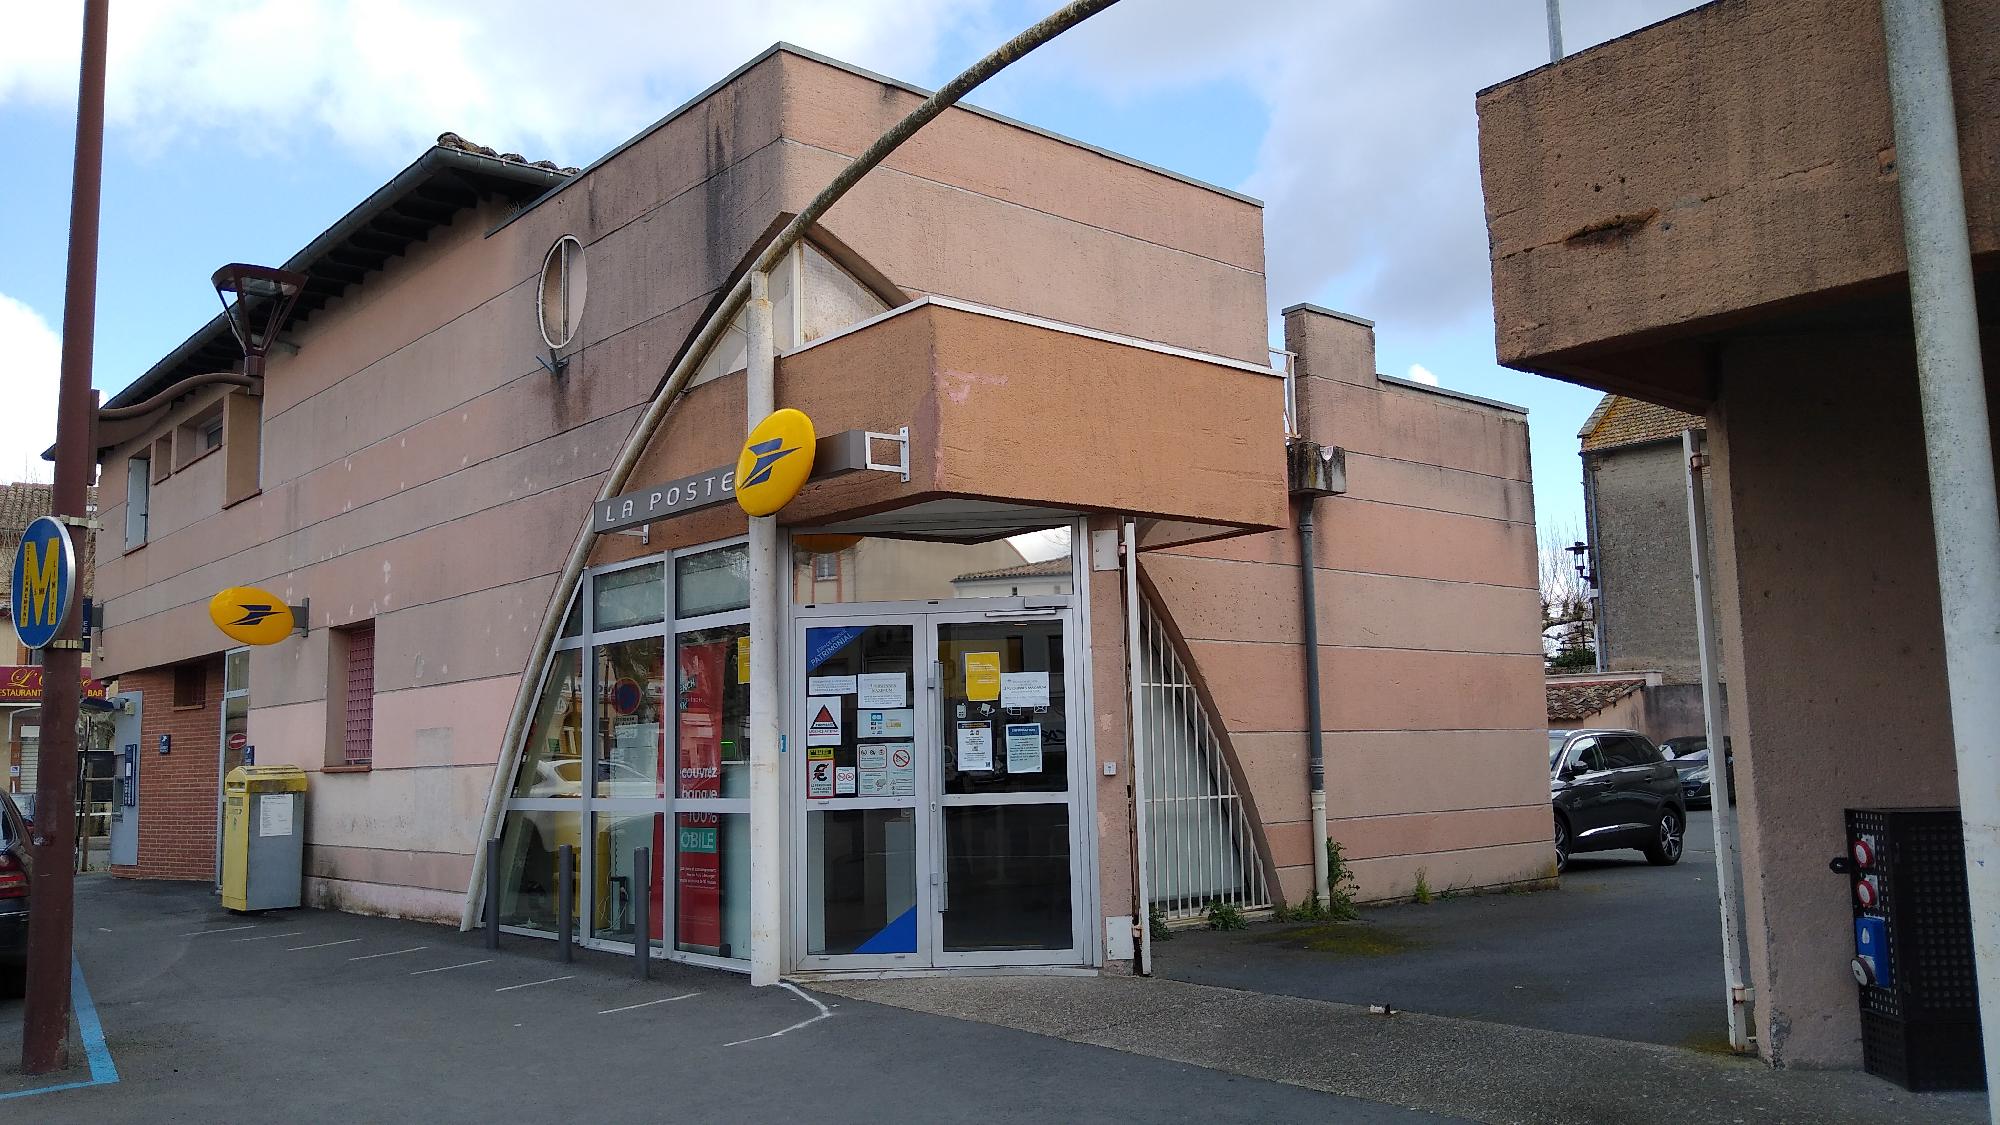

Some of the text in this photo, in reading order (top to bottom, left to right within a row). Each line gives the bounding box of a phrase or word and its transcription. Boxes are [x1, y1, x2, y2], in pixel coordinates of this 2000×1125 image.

[606, 471, 735, 522] LA POSTE
[810, 632, 854, 666] PATRIMONIAL
[87, 689, 103, 697] BAR
[680, 767, 717, 778] couvrez
[680, 831, 714, 849] OBILE
